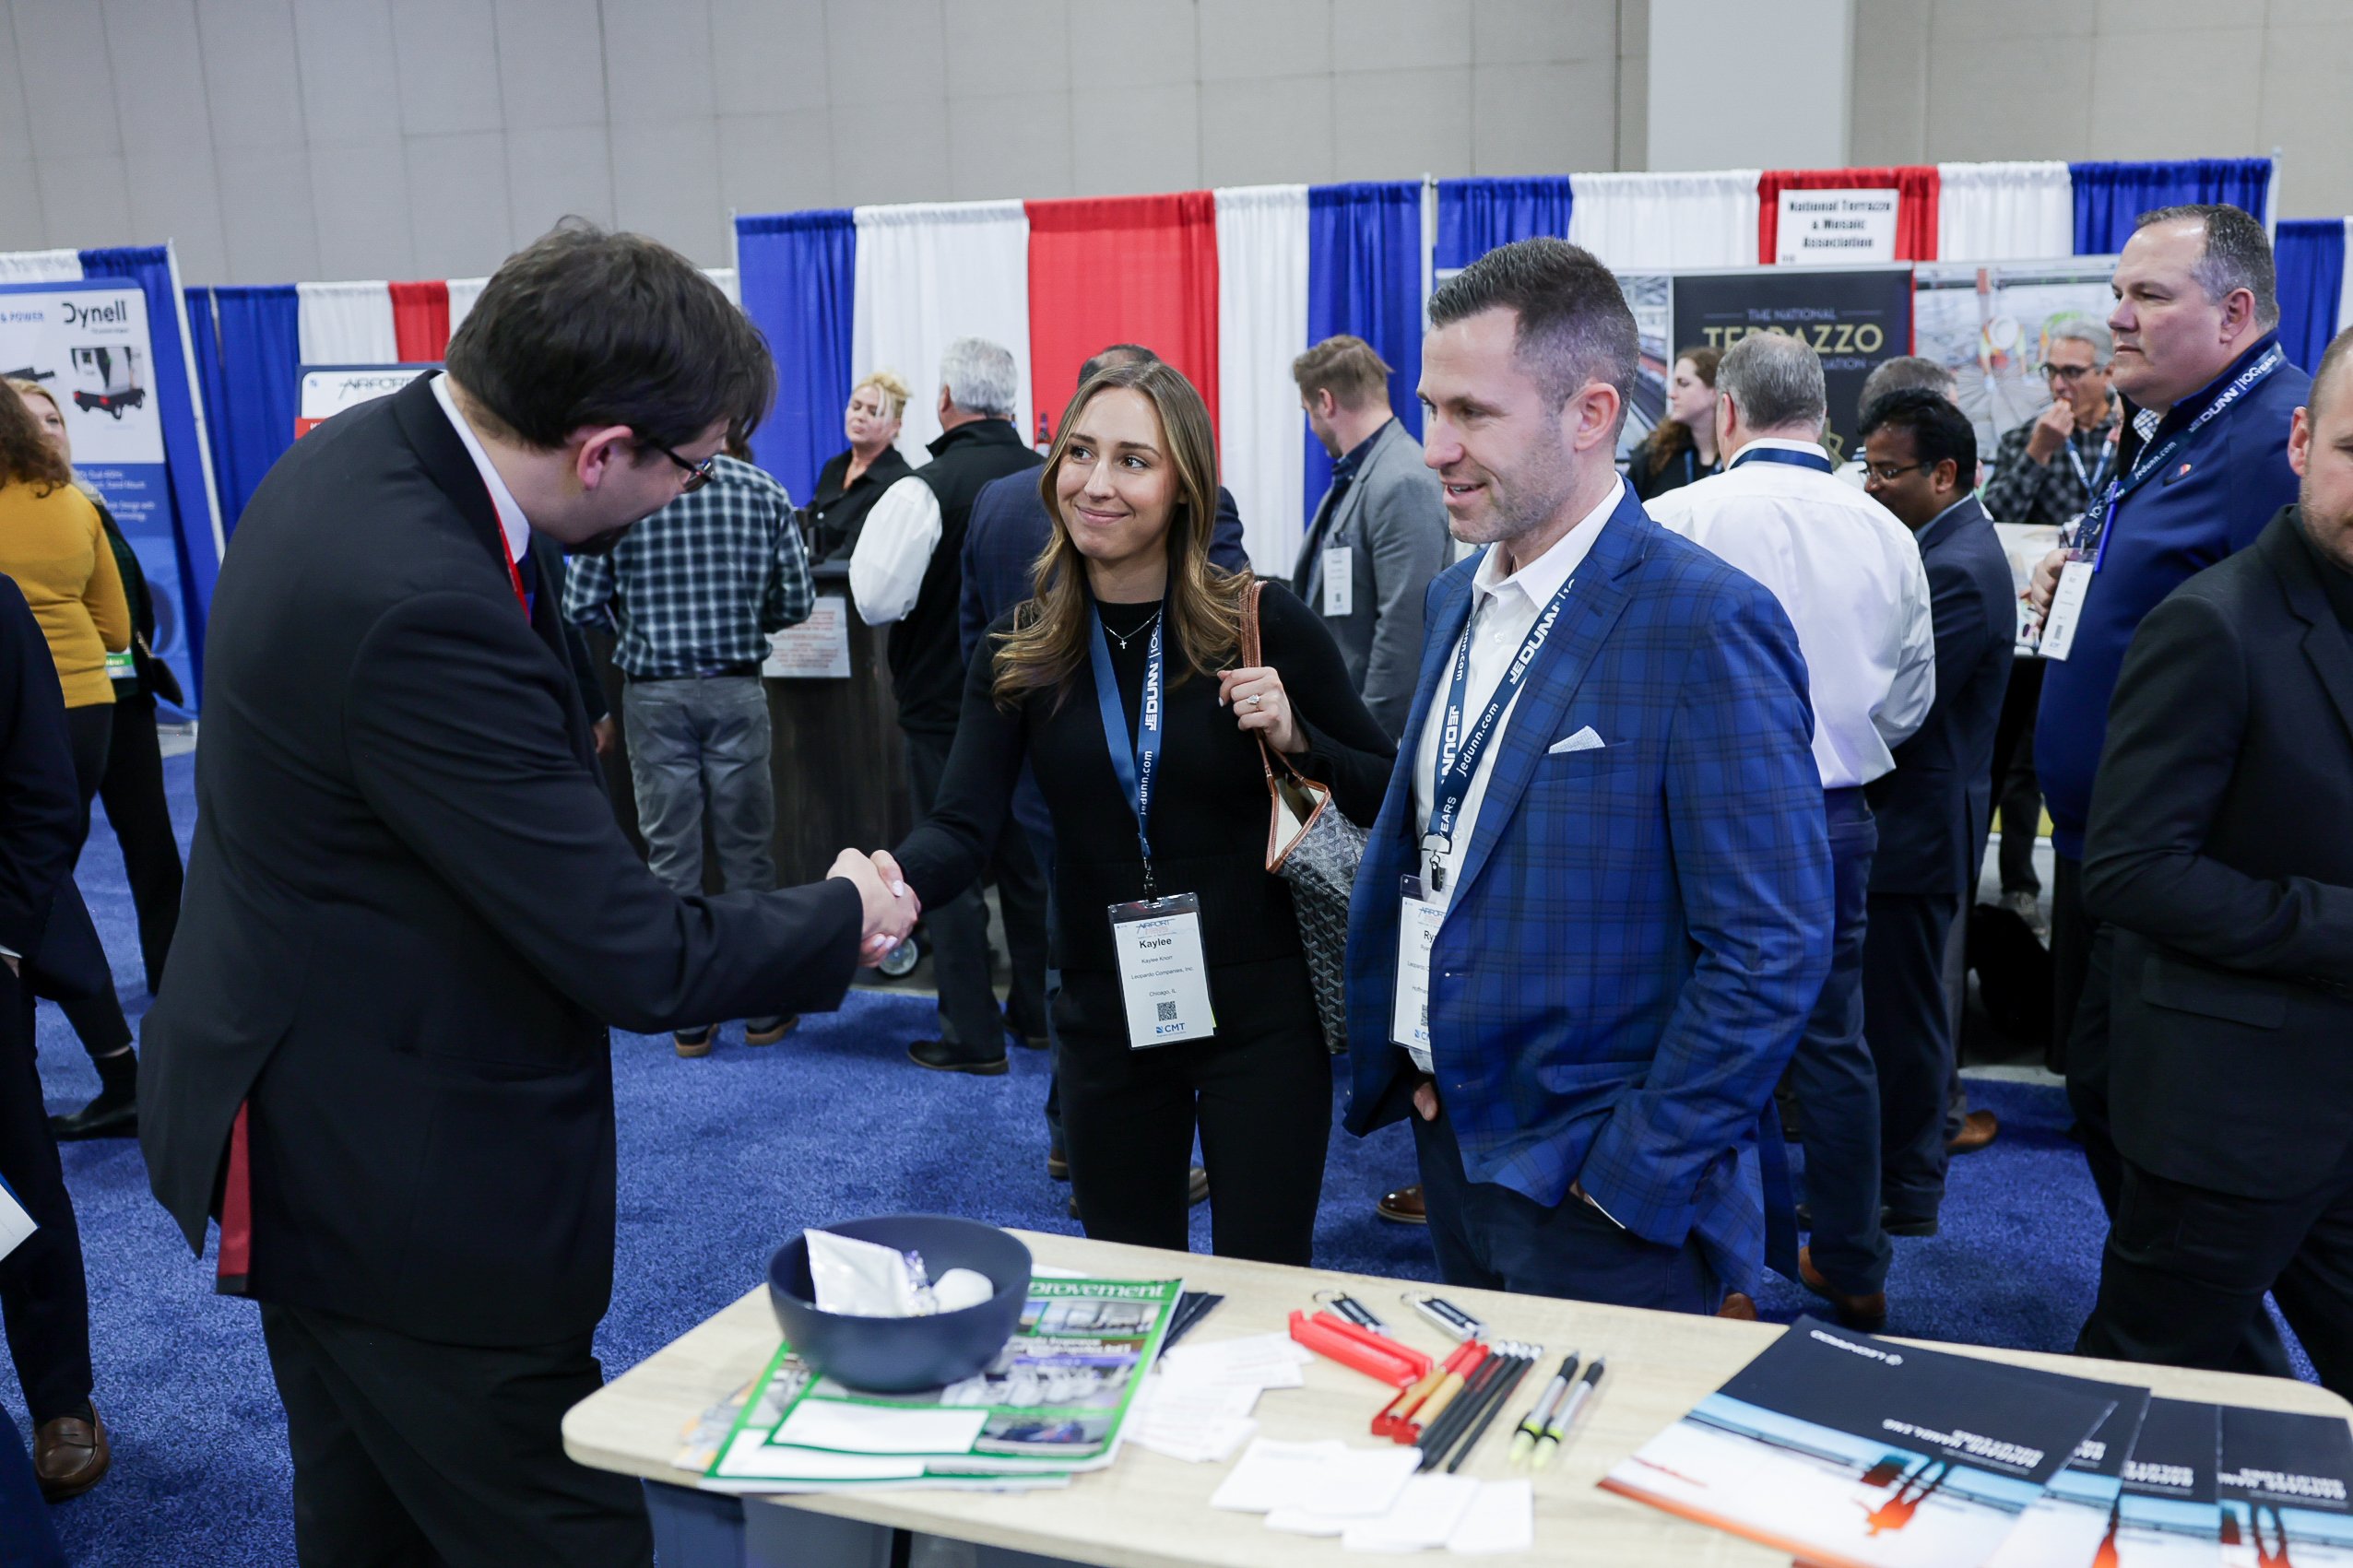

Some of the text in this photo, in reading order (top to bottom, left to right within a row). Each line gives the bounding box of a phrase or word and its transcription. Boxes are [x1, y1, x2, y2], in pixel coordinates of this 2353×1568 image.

[1790, 200, 1890, 212] National Terrazzo
[1824, 220, 1865, 230] Mosaic
[1803, 238, 1873, 248] Association
[62, 300, 127, 328] Dynell
[1747, 308, 1838, 321] THE NATIONAL
[1702, 324, 1884, 353] TEAZZO
[1456, 615, 1471, 681] dunn.com
[1440, 705, 1460, 784] JEDUN
[1456, 702, 1499, 777] jedunn.com
[1140, 750, 1153, 815] jedunn.com
[1140, 937, 1172, 949] Kaylee
[1131, 972, 1155, 980] Leopardo
[1165, 1022, 1186, 1032] CMT
